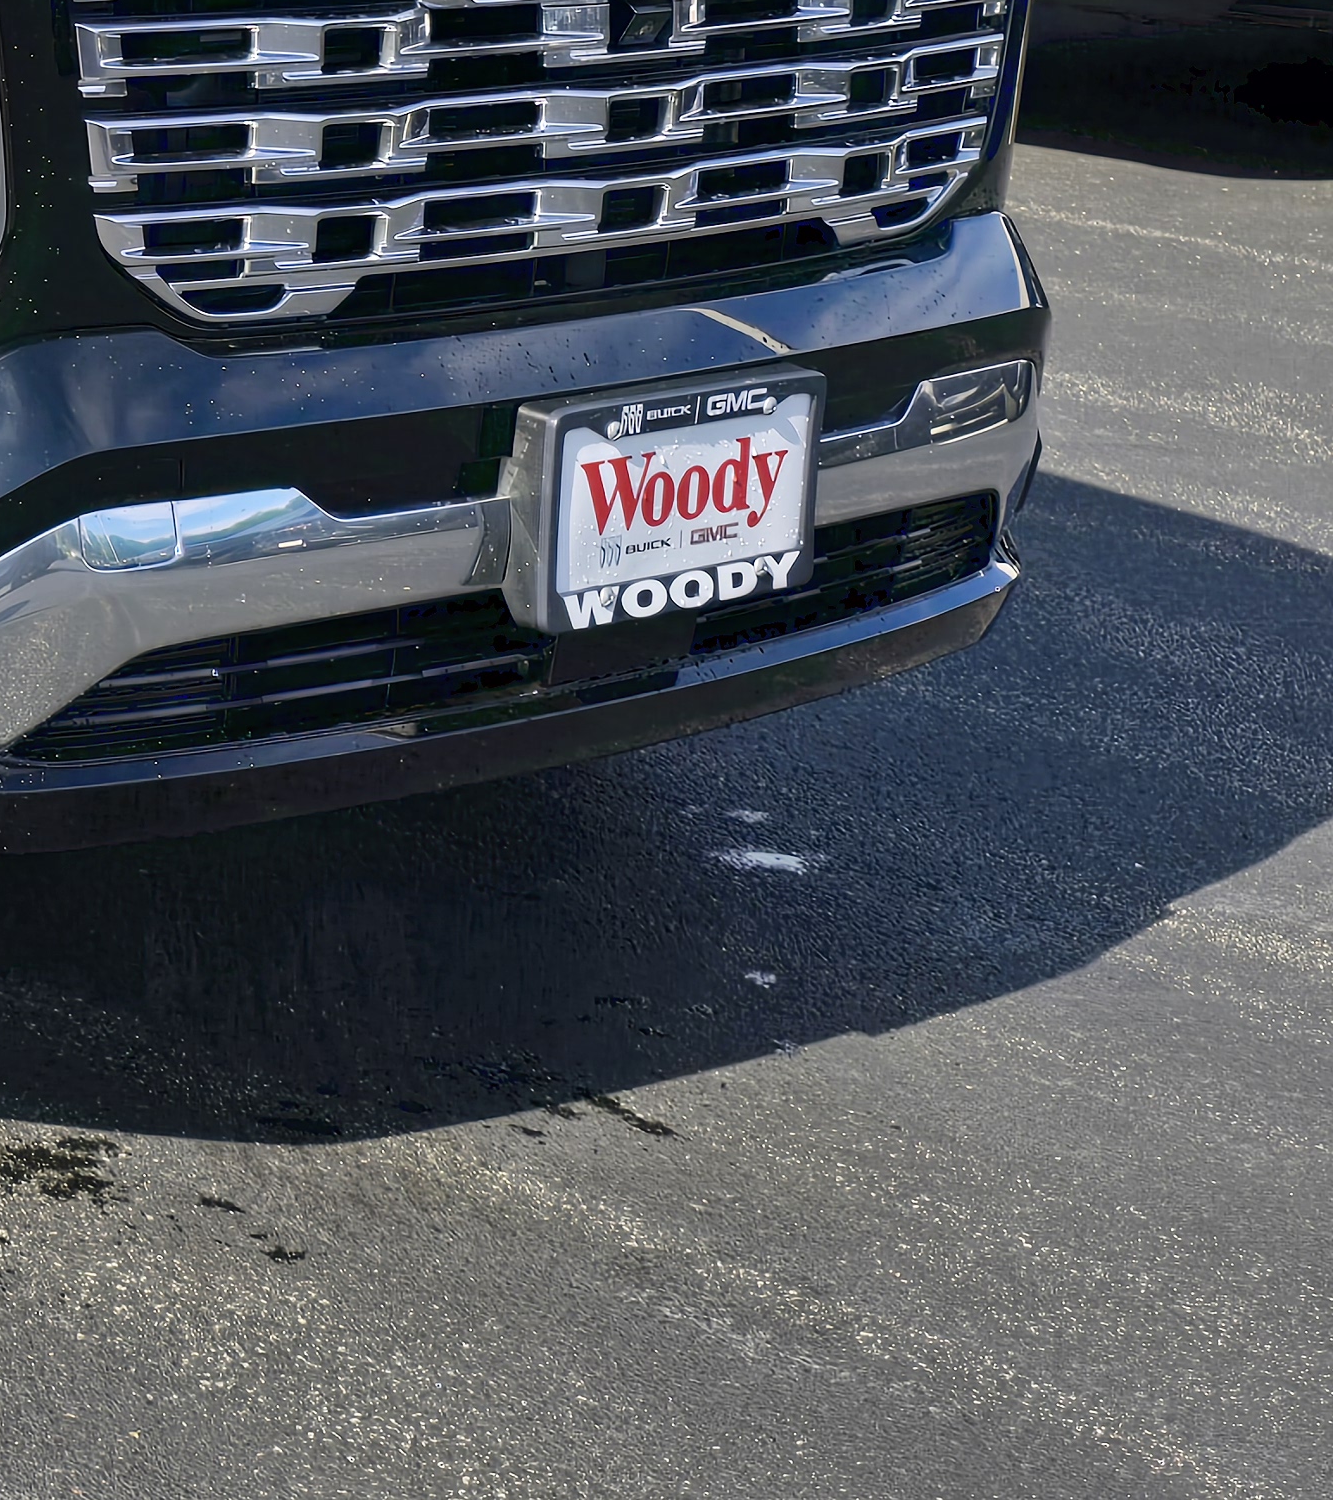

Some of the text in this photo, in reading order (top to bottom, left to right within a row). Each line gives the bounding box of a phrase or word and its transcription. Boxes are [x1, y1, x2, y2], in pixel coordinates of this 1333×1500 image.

[646, 387, 768, 421] BUICK GMC
[581, 436, 789, 536] Woody
[625, 522, 739, 555] BUICK GMC
[563, 551, 801, 630] WOODY
